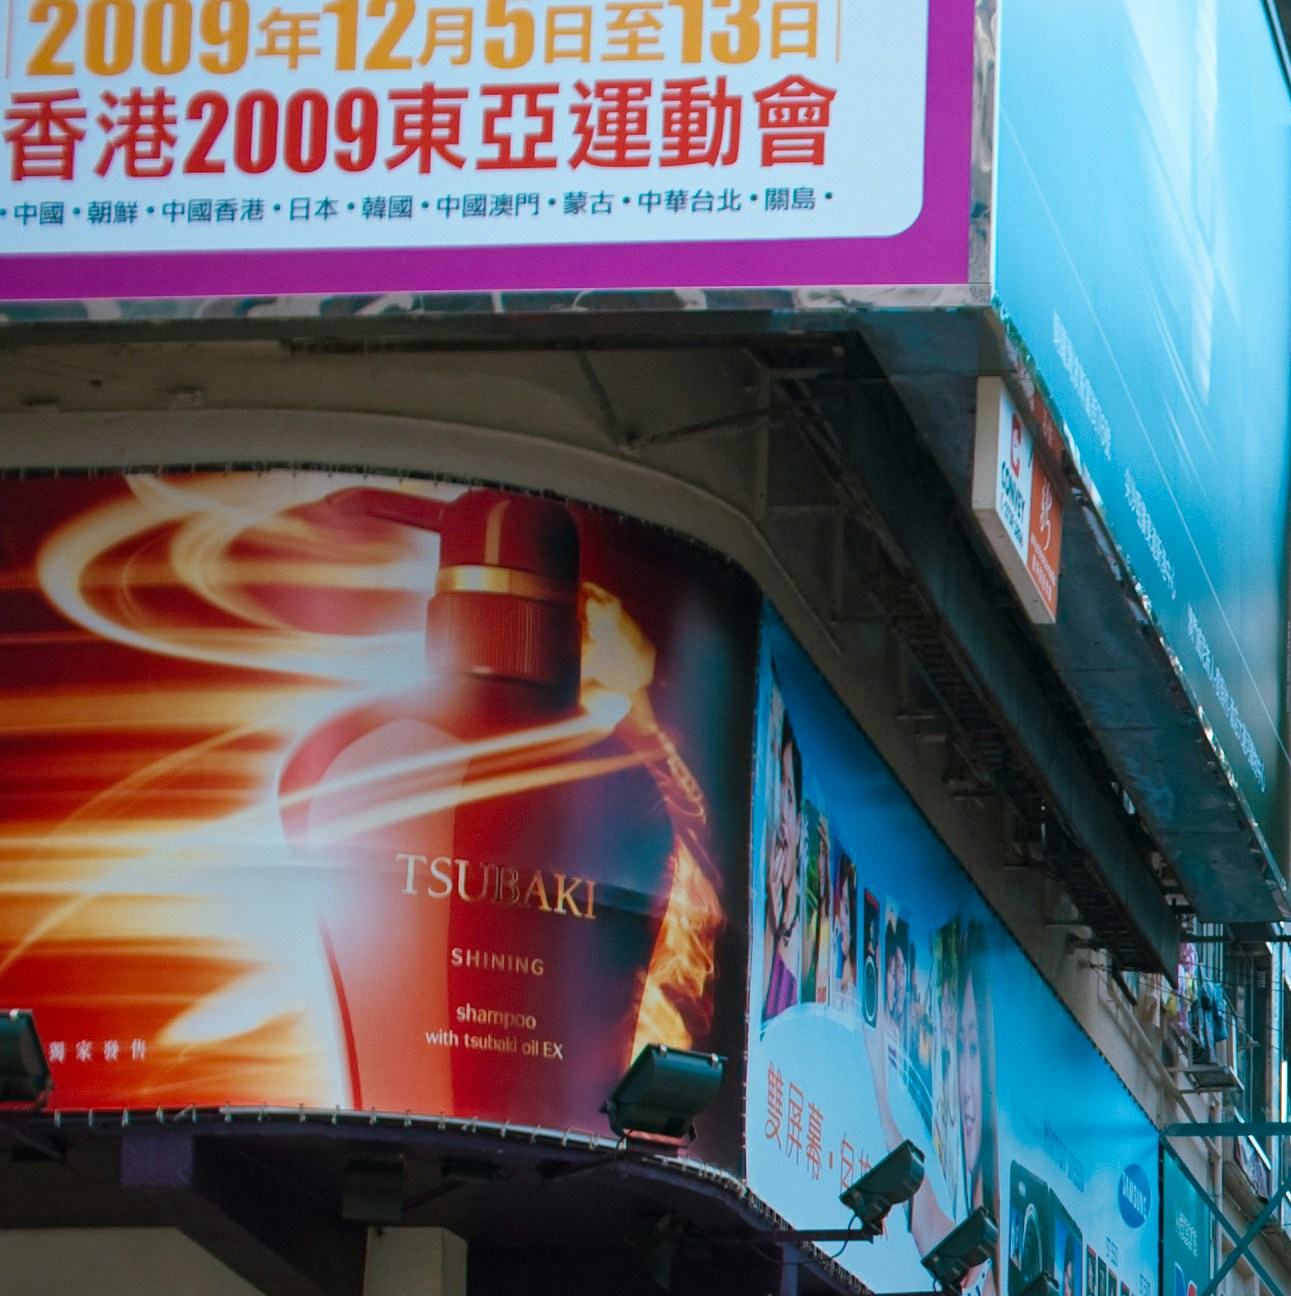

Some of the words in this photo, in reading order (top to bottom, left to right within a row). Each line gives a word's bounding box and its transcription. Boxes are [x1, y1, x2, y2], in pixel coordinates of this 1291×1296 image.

[3, 76, 839, 182] 香港2009東亞運動會
[396, 852, 598, 919] TSUBAKI
[451, 947, 545, 976] SHINING
[456, 1002, 537, 1030] shampoo
[425, 1029, 460, 1049] with
[464, 1032, 518, 1054] tsubaki
[521, 1038, 539, 1056] oil
[542, 1042, 564, 1060] EX
[1121, 1172, 1147, 1220] SAMSUNG
